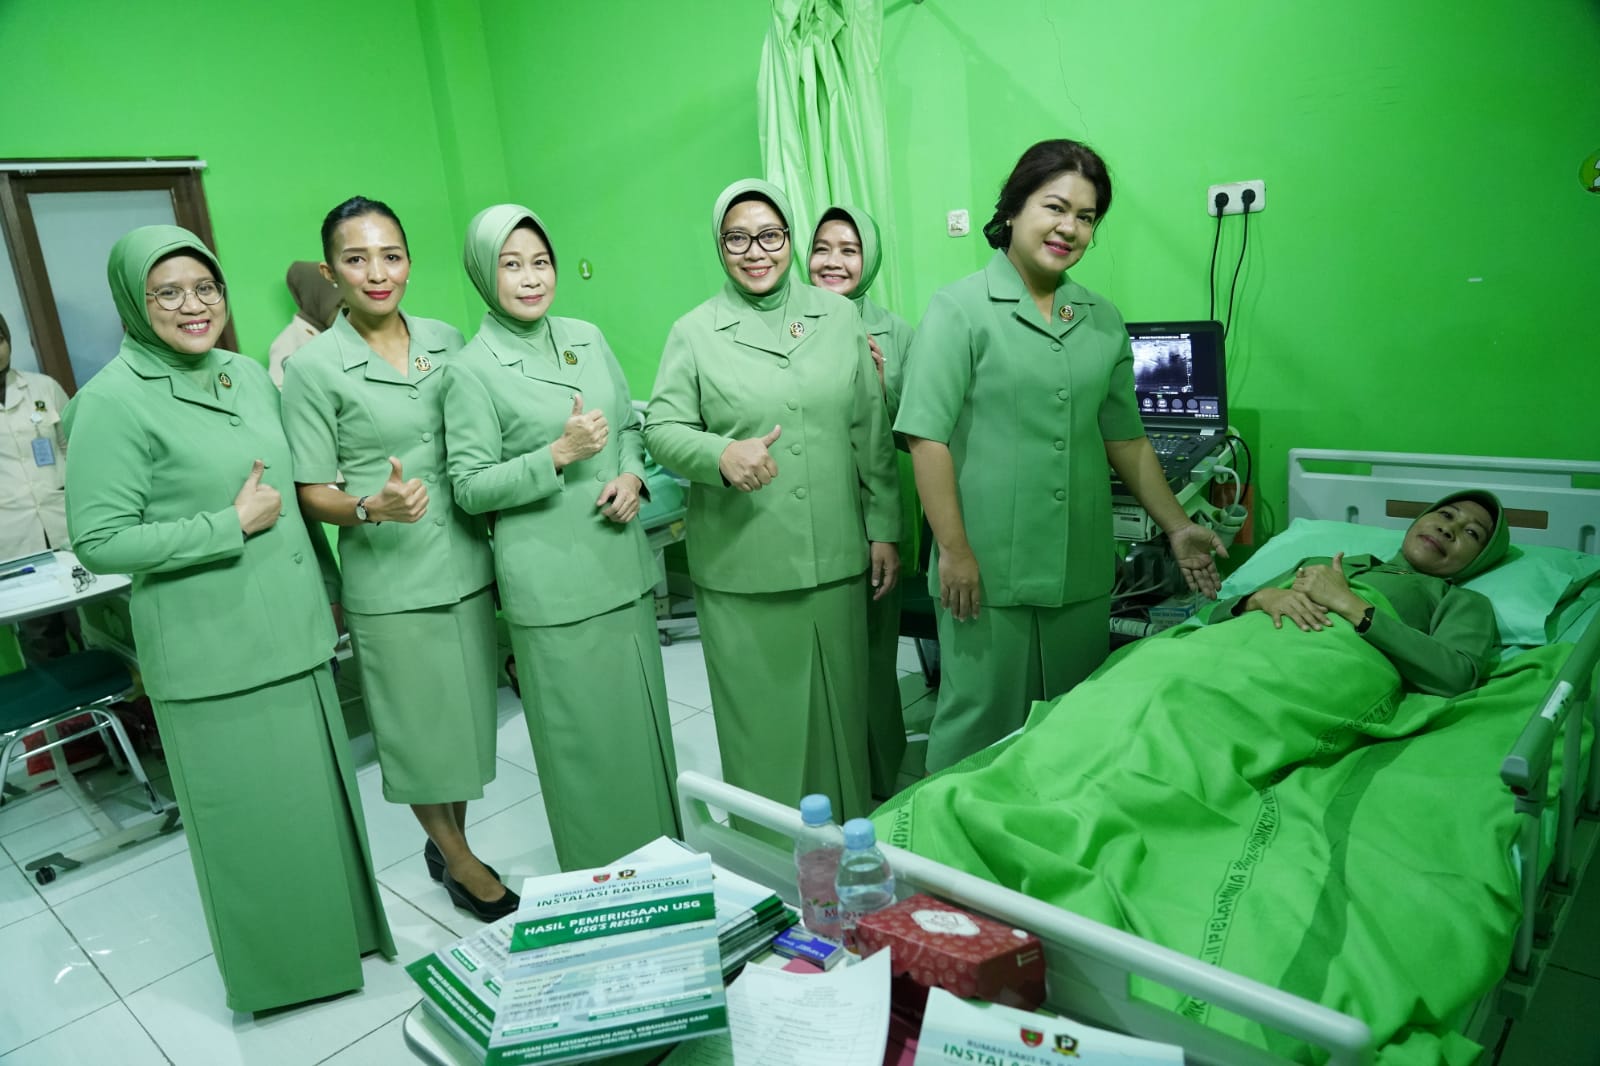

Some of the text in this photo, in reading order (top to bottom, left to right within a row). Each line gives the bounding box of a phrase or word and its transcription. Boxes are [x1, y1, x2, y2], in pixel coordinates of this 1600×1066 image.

[582, 261, 590, 277] 1
[537, 878, 689, 907] INSTALASI RADIOLOGI
[524, 900, 701, 936] HASIL PEMERIKSAAN USG
[574, 916, 653, 935] USG'S RESULT
[967, 1039, 1005, 1054] RUMAH
